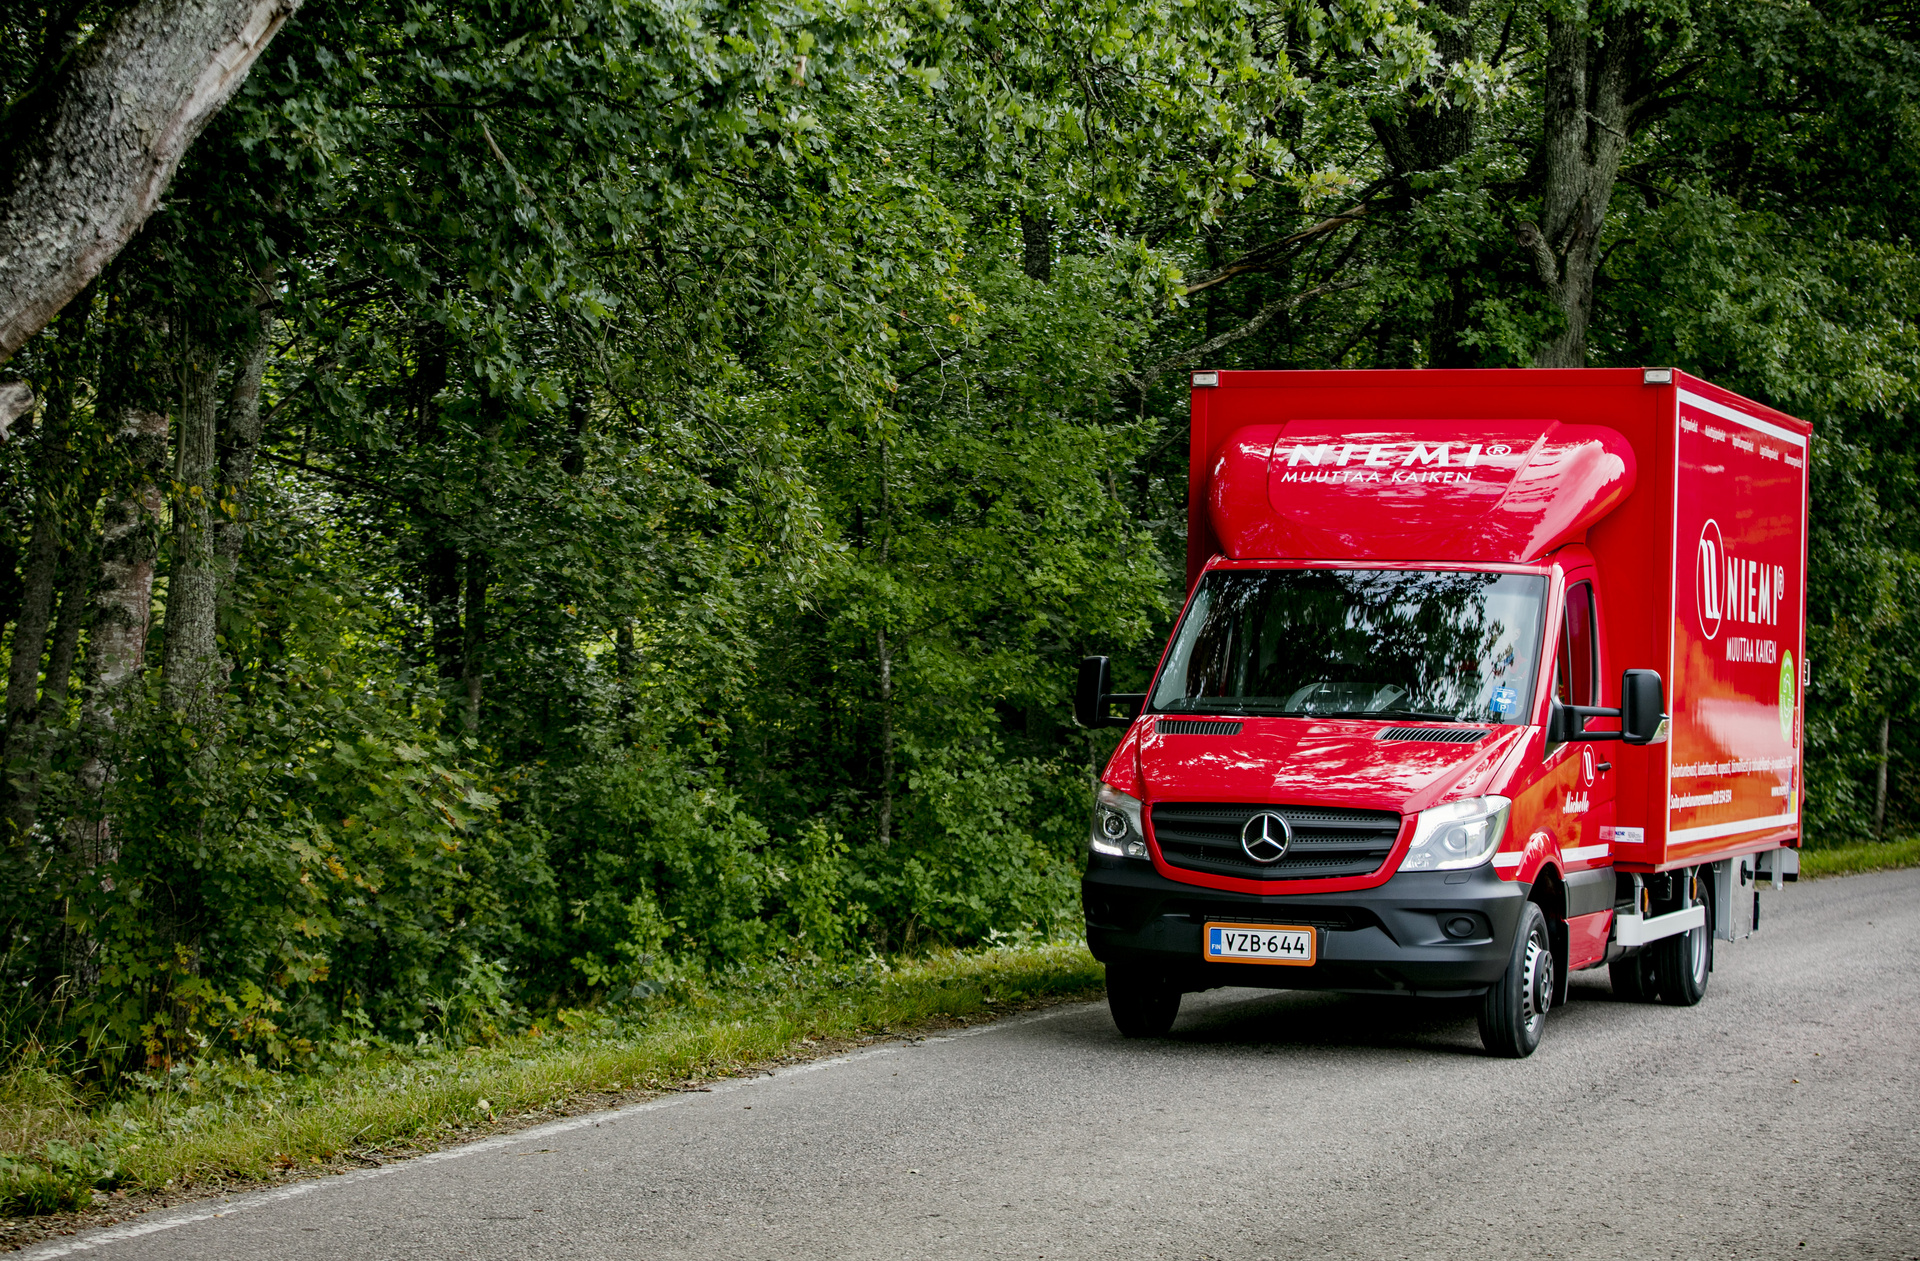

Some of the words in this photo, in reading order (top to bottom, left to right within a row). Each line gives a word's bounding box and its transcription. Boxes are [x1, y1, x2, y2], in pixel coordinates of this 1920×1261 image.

[1281, 471, 1380, 484] MUUTTAA
[1391, 471, 1472, 484] KAIKEN
[1726, 636, 1754, 663] MUUTTAA
[1755, 638, 1777, 664] KAIKEN
